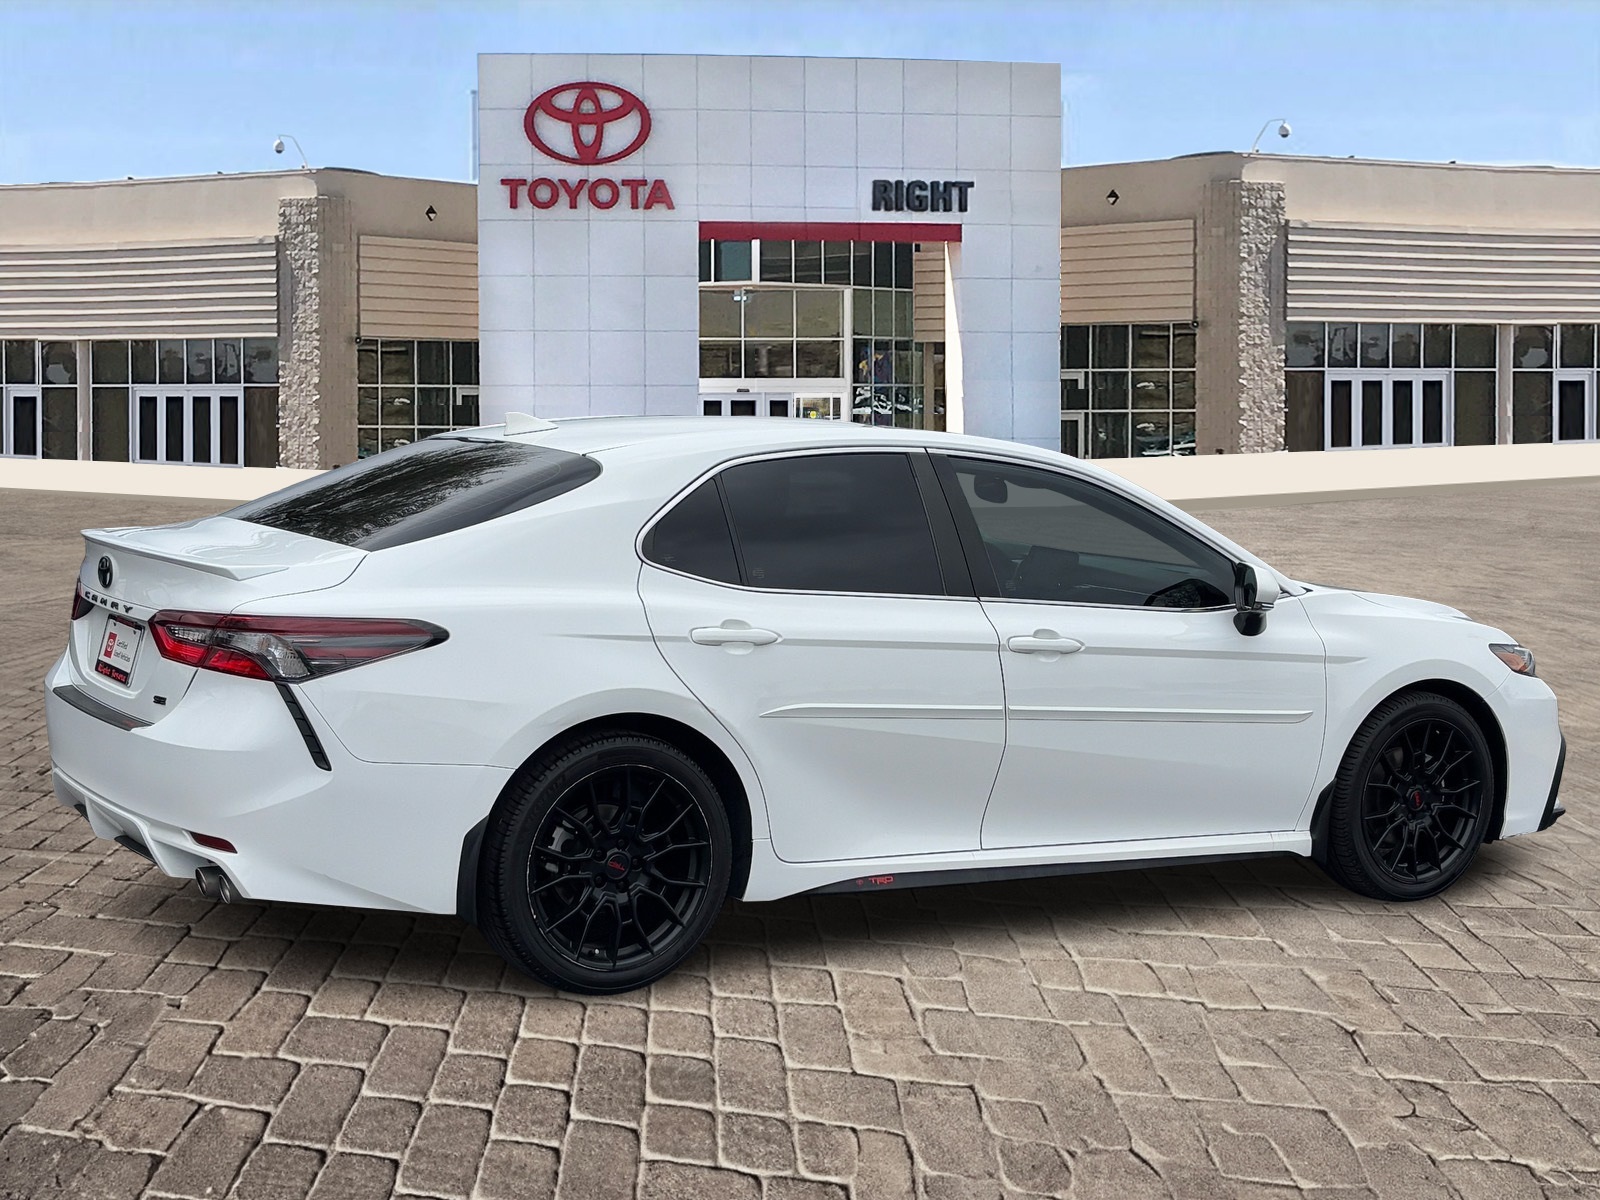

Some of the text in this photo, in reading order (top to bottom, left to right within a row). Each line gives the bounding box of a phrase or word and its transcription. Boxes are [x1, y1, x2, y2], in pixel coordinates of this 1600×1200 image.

[500, 178, 675, 209] TOYOTA
[872, 180, 975, 212] RIGHT
[84, 591, 133, 614] CAMRY
[868, 874, 894, 885] TRD
